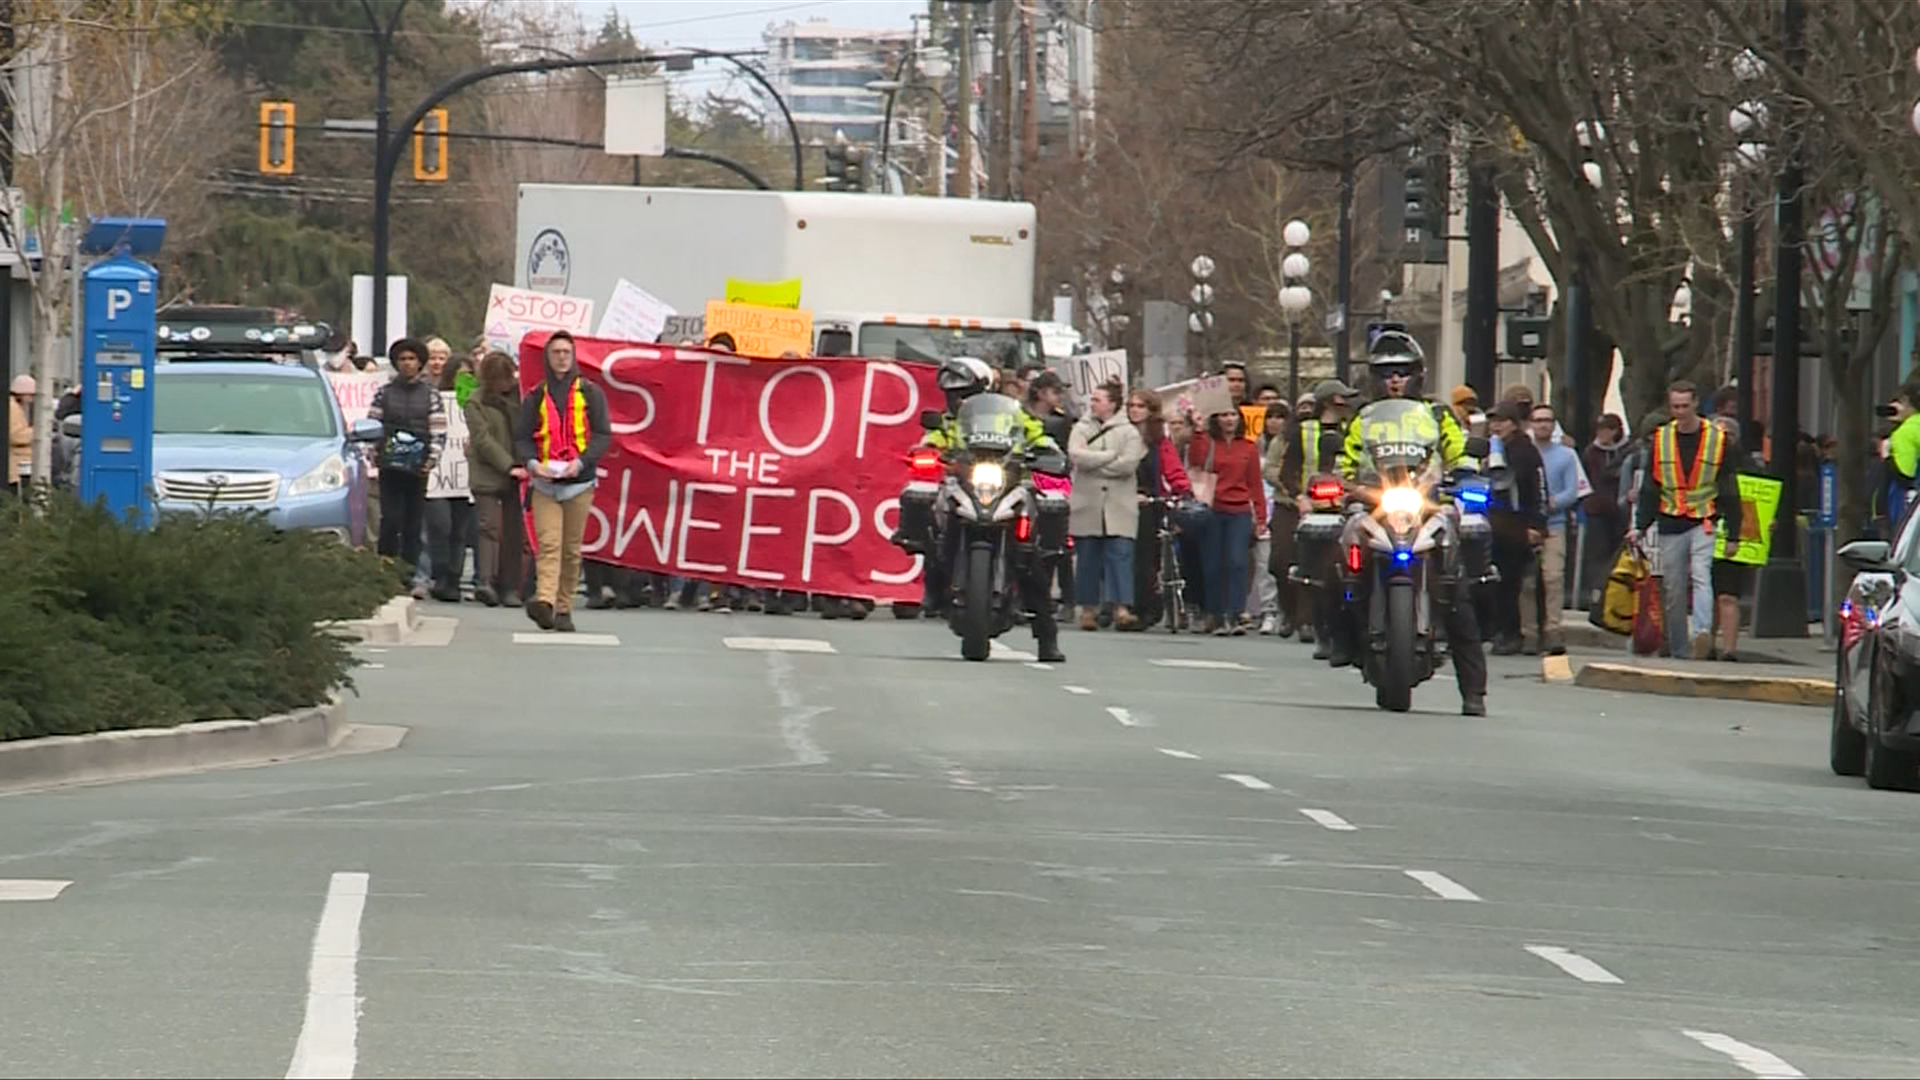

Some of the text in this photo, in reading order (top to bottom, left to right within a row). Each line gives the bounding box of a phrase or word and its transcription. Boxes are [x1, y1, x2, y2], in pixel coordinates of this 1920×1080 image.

[107, 288, 132, 320] P
[508, 294, 589, 328] STOP!
[666, 315, 705, 336] STO
[768, 317, 805, 339] AID
[601, 349, 919, 459] STOP
[704, 449, 780, 484] THE
